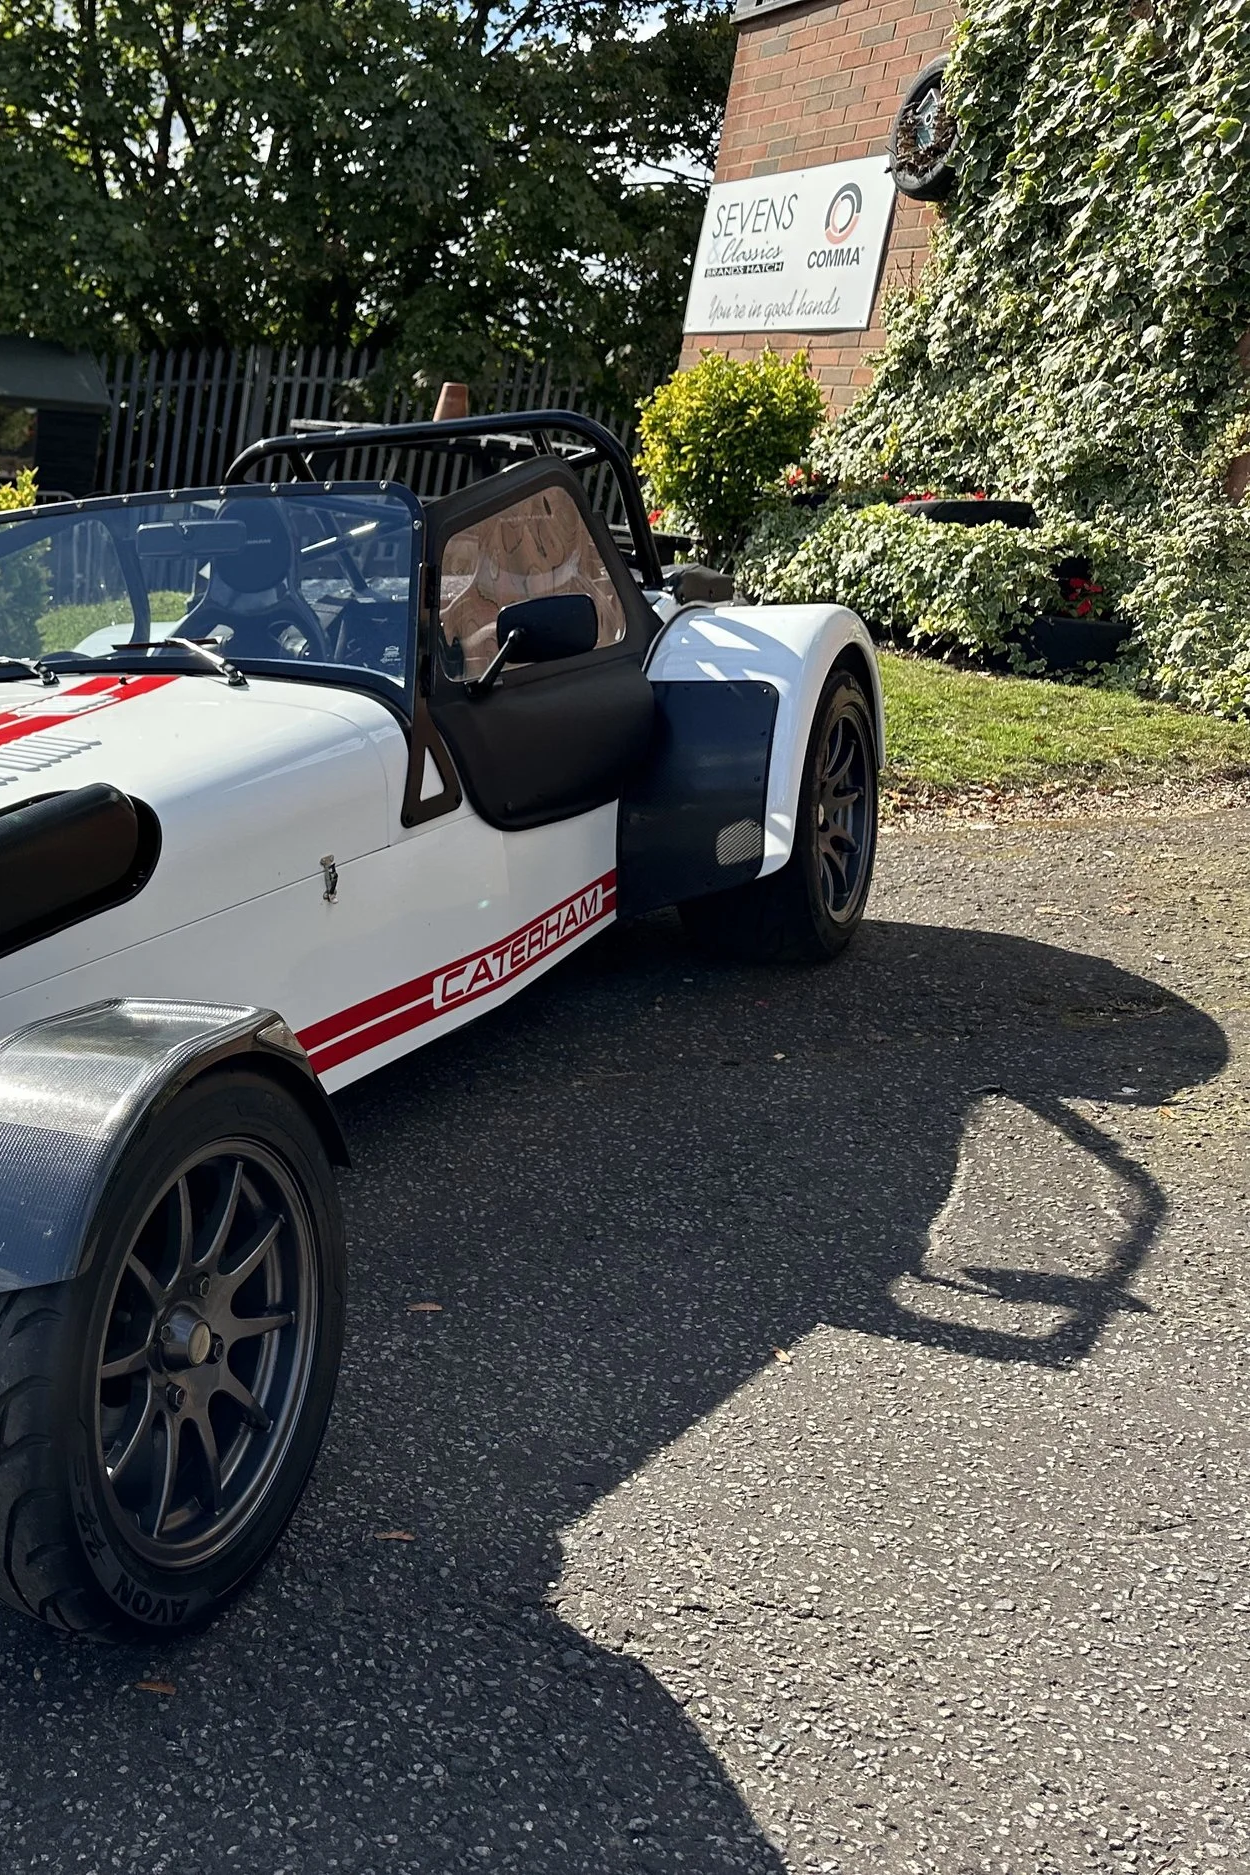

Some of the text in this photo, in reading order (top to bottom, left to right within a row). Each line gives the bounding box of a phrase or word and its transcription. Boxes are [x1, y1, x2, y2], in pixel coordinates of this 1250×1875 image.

[712, 193, 798, 238] SEVENS
[705, 262, 783, 277] BRANDS HATCH
[721, 238, 782, 264] Classics
[807, 247, 861, 269] COMMA
[709, 286, 841, 327] You're in good hands
[441, 888, 599, 1004] CATERHAM
[112, 1574, 191, 1624] AVON
